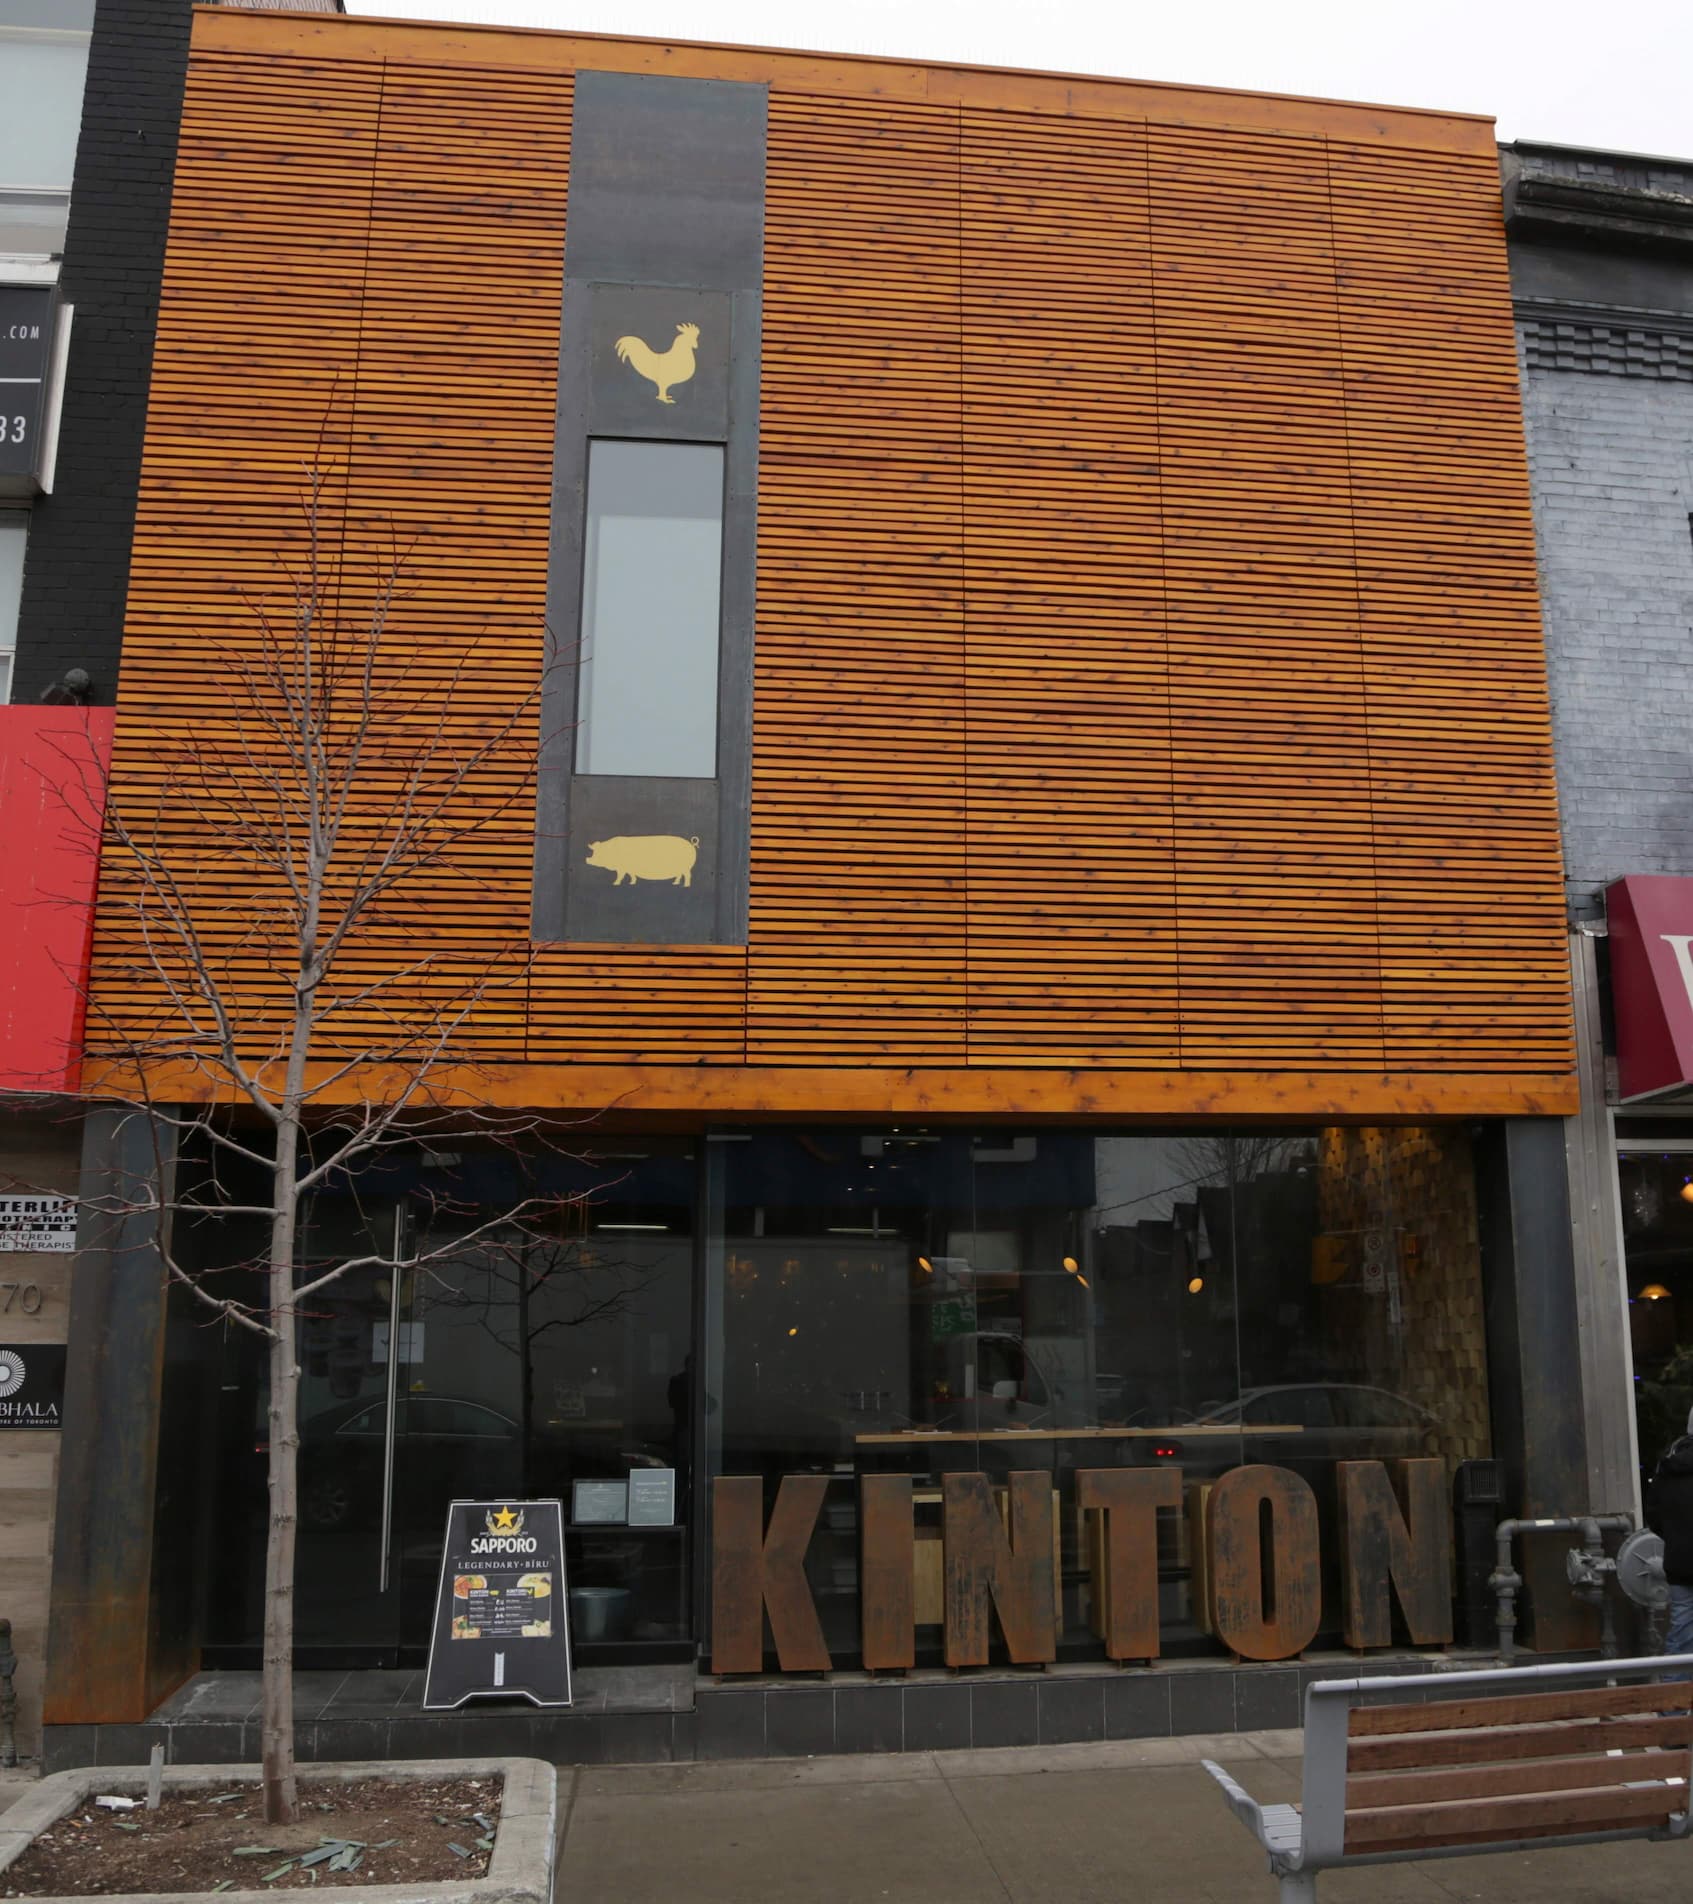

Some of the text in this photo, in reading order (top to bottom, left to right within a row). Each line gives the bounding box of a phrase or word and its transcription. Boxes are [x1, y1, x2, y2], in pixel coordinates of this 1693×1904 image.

[470, 1537, 538, 1554] SAPPORO
[458, 1560, 520, 1570] LEGENDARY
[712, 1457, 1454, 1674] KINTON
